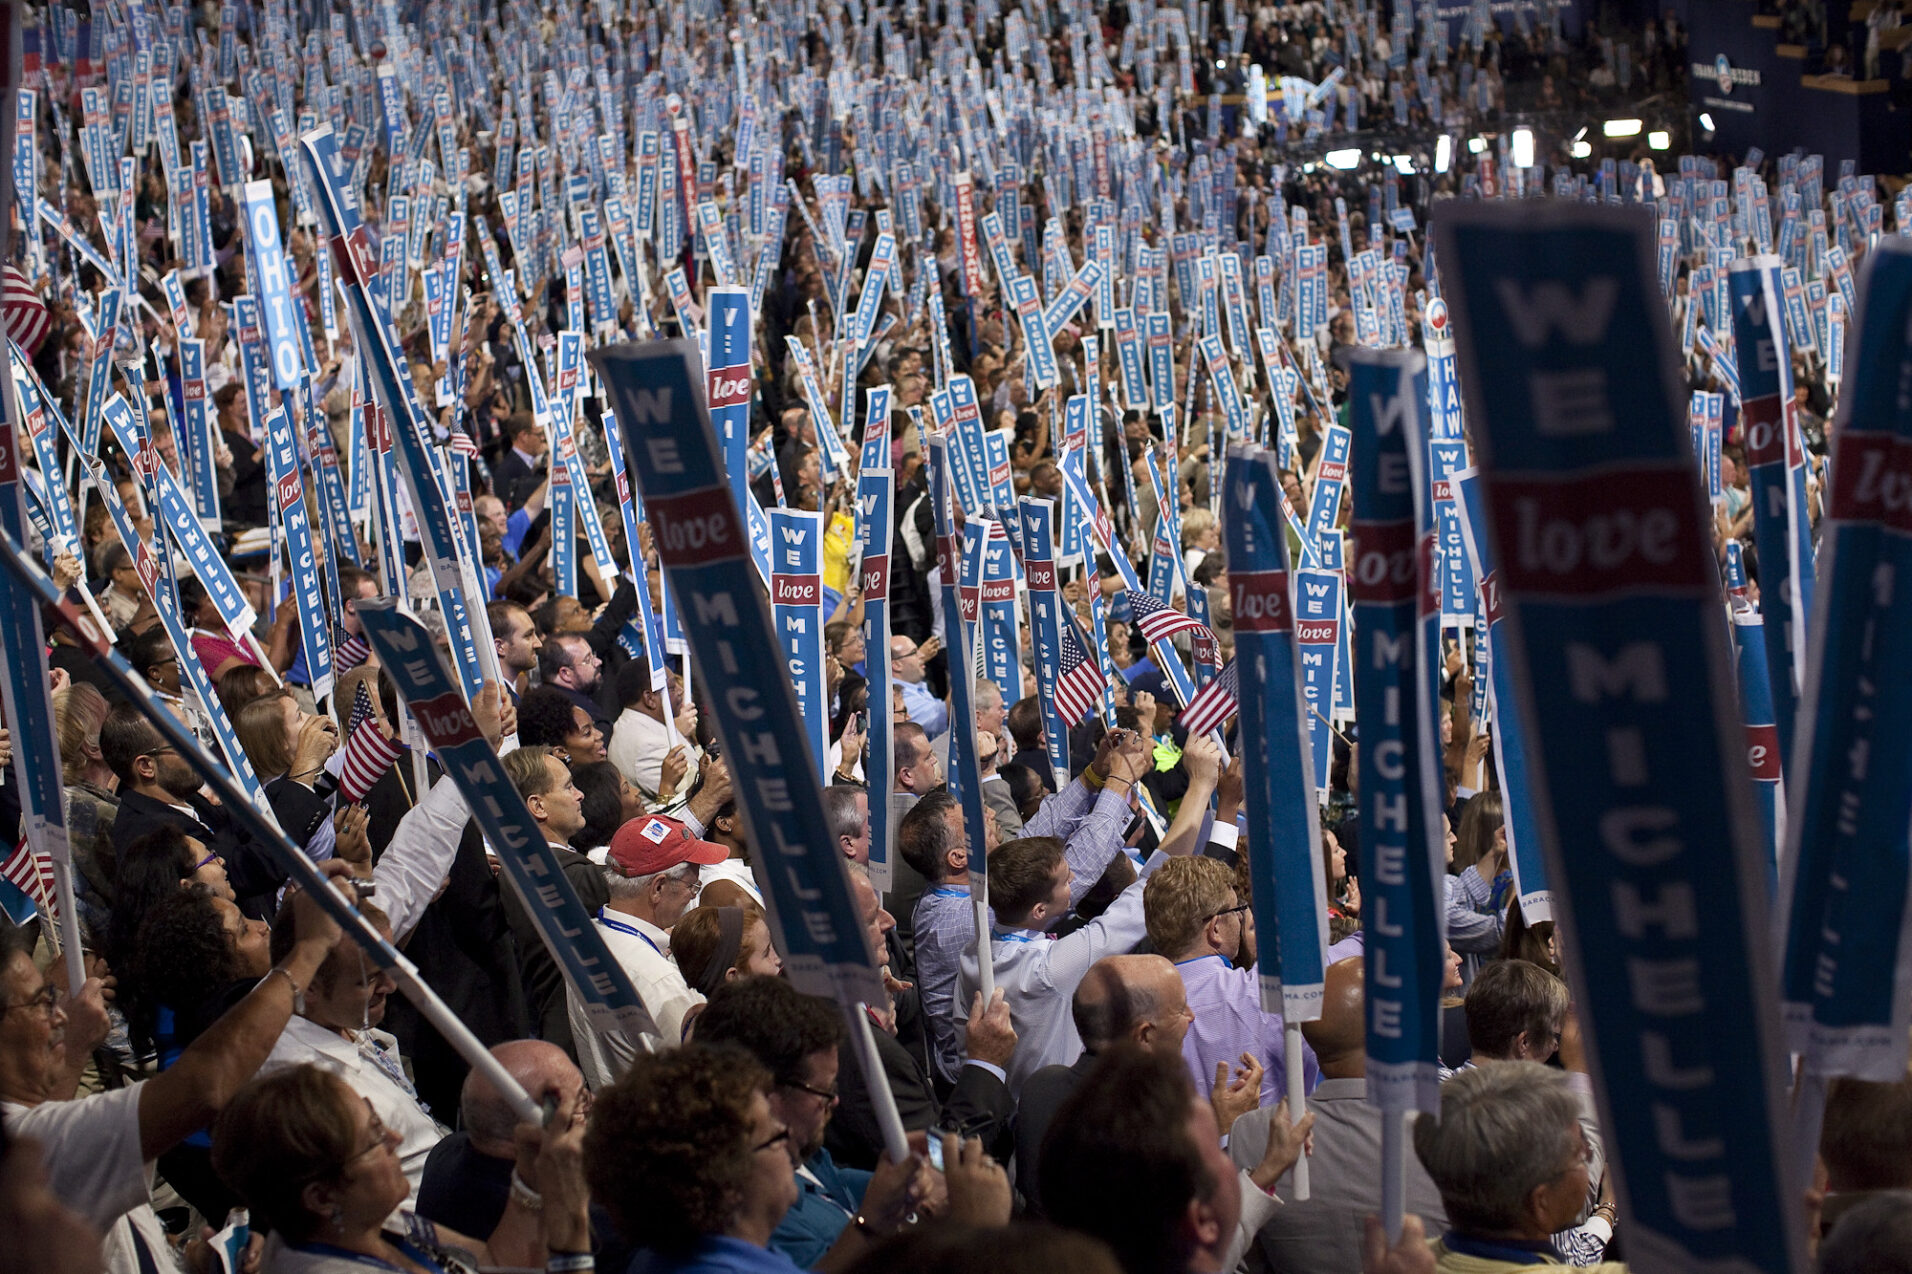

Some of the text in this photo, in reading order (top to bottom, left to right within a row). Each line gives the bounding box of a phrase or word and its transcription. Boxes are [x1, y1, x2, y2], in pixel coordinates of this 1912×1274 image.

[958, 185, 980, 295] PENNSYLVANIA
[253, 207, 299, 383] OHIO
[624, 386, 685, 474] WE
[990, 441, 1004, 462] WE
[1332, 434, 1347, 460] WE
[113, 411, 139, 443] WE
[159, 482, 236, 611] MICHELLE
[272, 425, 292, 465] WE
[290, 513, 330, 668] MICHELLE
[657, 510, 730, 552] love
[780, 526, 806, 566] WE
[1444, 506, 1465, 610] MICHELLE
[778, 579, 814, 600] love
[983, 585, 1010, 597] love
[986, 549, 1003, 575] WE
[1306, 582, 1330, 614] WE
[1026, 517, 1041, 553] WE
[1035, 602, 1060, 759] MICHELLE
[1297, 625, 1332, 641] love
[691, 590, 837, 944] MICHELLE
[1494, 276, 1738, 1229] WE love MICHELLE
[377, 628, 617, 995] WE love MICHELLE
[1372, 629, 1410, 1039] MICHELLE
